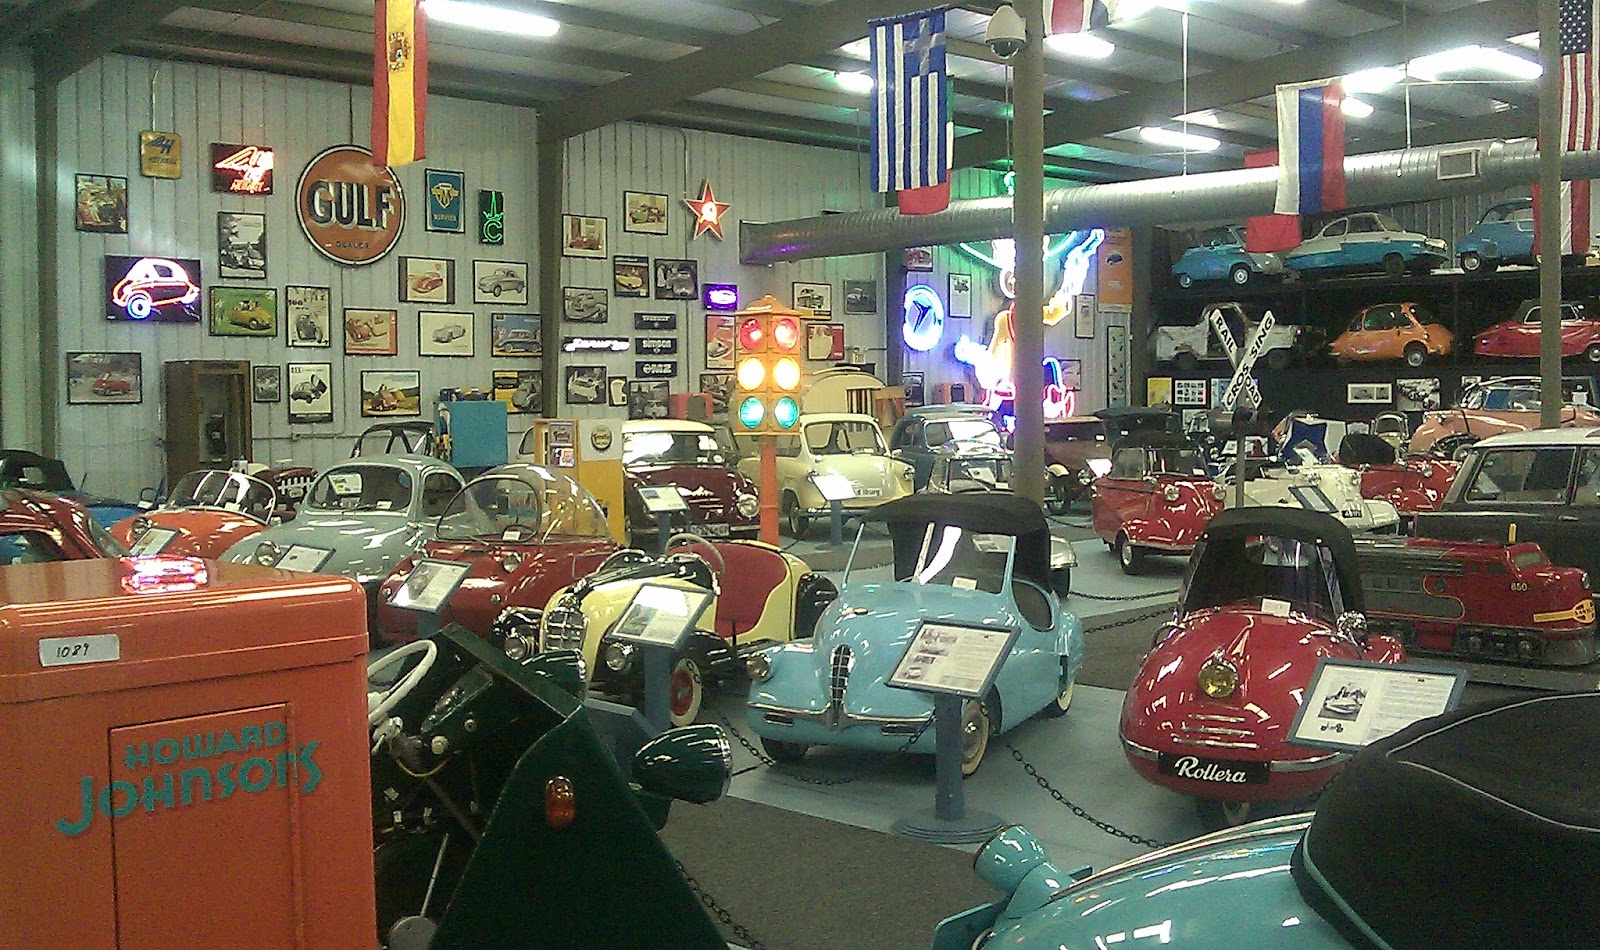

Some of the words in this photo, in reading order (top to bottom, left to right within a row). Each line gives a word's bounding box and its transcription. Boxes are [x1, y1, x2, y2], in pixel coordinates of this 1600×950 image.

[307, 179, 395, 231] GULF
[336, 240, 370, 250] DEALER
[1215, 316, 1236, 353] RAIL
[56, 642, 91, 658] 1089
[123, 721, 288, 770] HOWARD
[1174, 756, 1247, 784] Rollera
